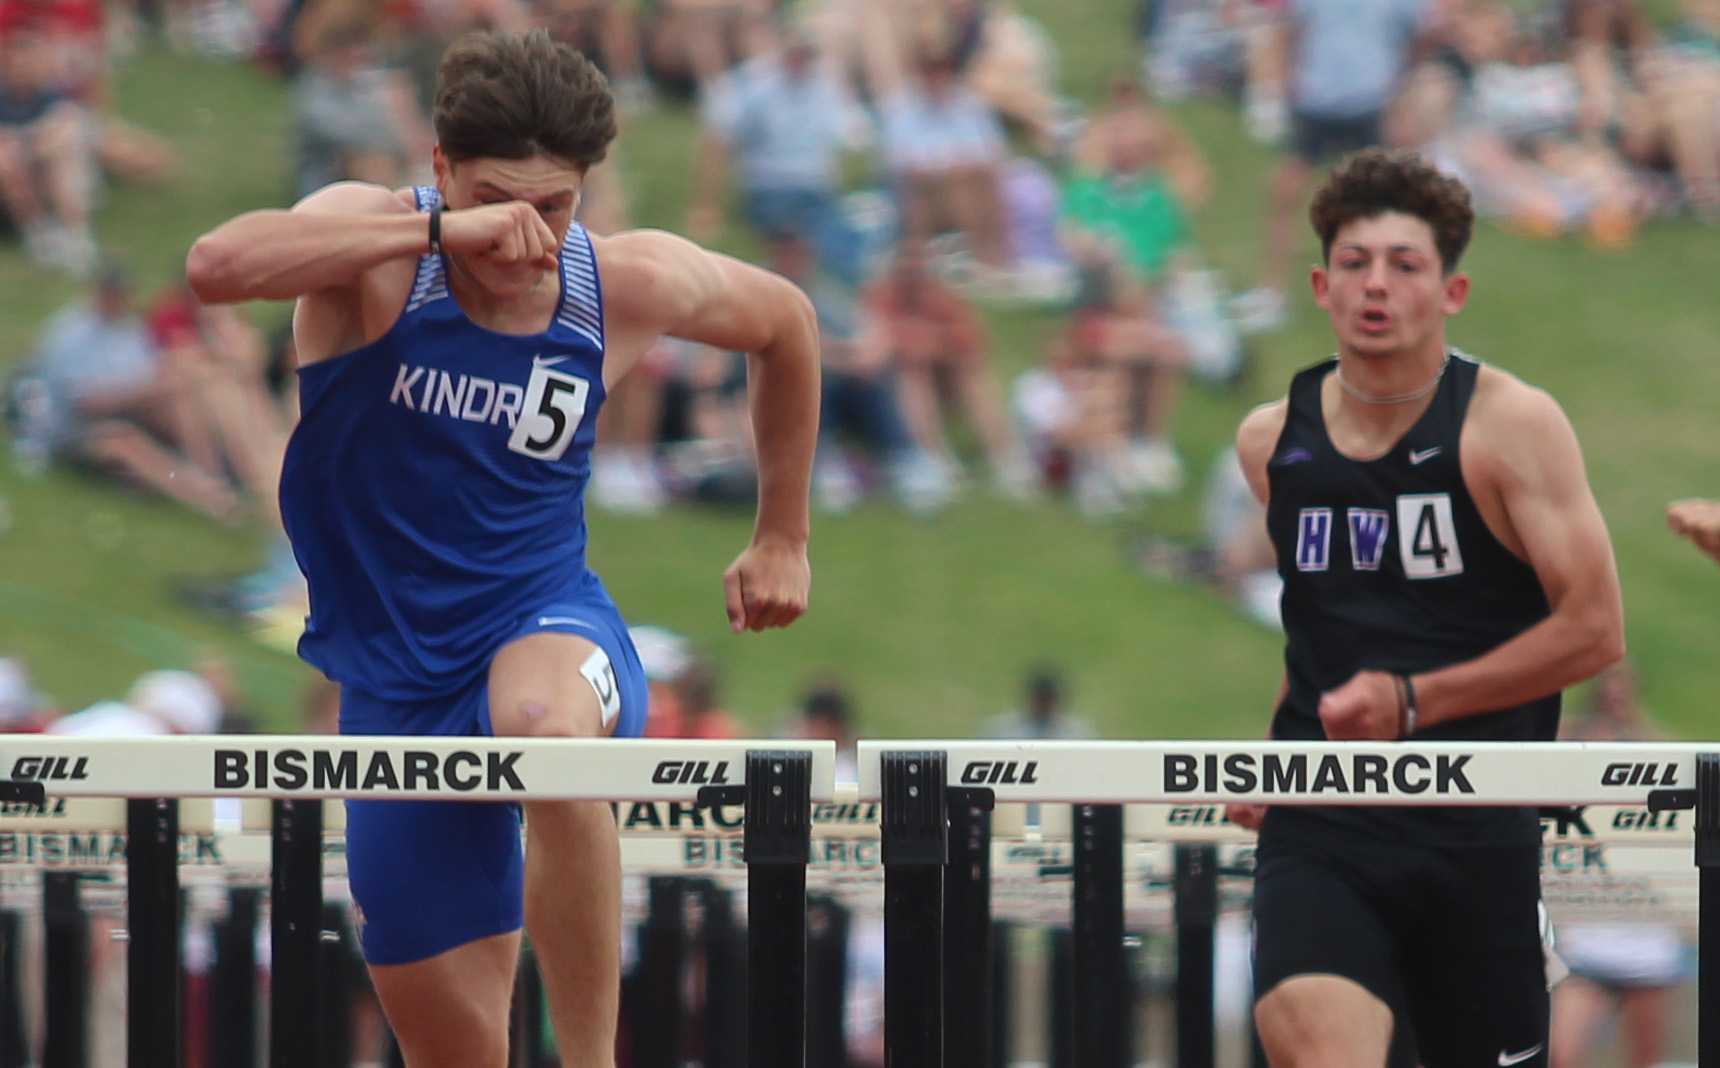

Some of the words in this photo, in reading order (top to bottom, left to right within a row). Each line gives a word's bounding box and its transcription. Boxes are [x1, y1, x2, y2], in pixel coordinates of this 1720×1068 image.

[390, 363, 522, 430] KINDR
[525, 377, 575, 451] 5
[1412, 503, 1448, 569] 4
[10, 756, 90, 781] GILL
[213, 748, 527, 792] BISMARCK
[651, 760, 730, 785] GILL
[960, 761, 1038, 785] GILL
[1163, 753, 1476, 794] BISMARCK
[1600, 763, 1679, 787] GILL
[812, 803, 878, 824] GILL
[1612, 810, 1680, 831] GILL
